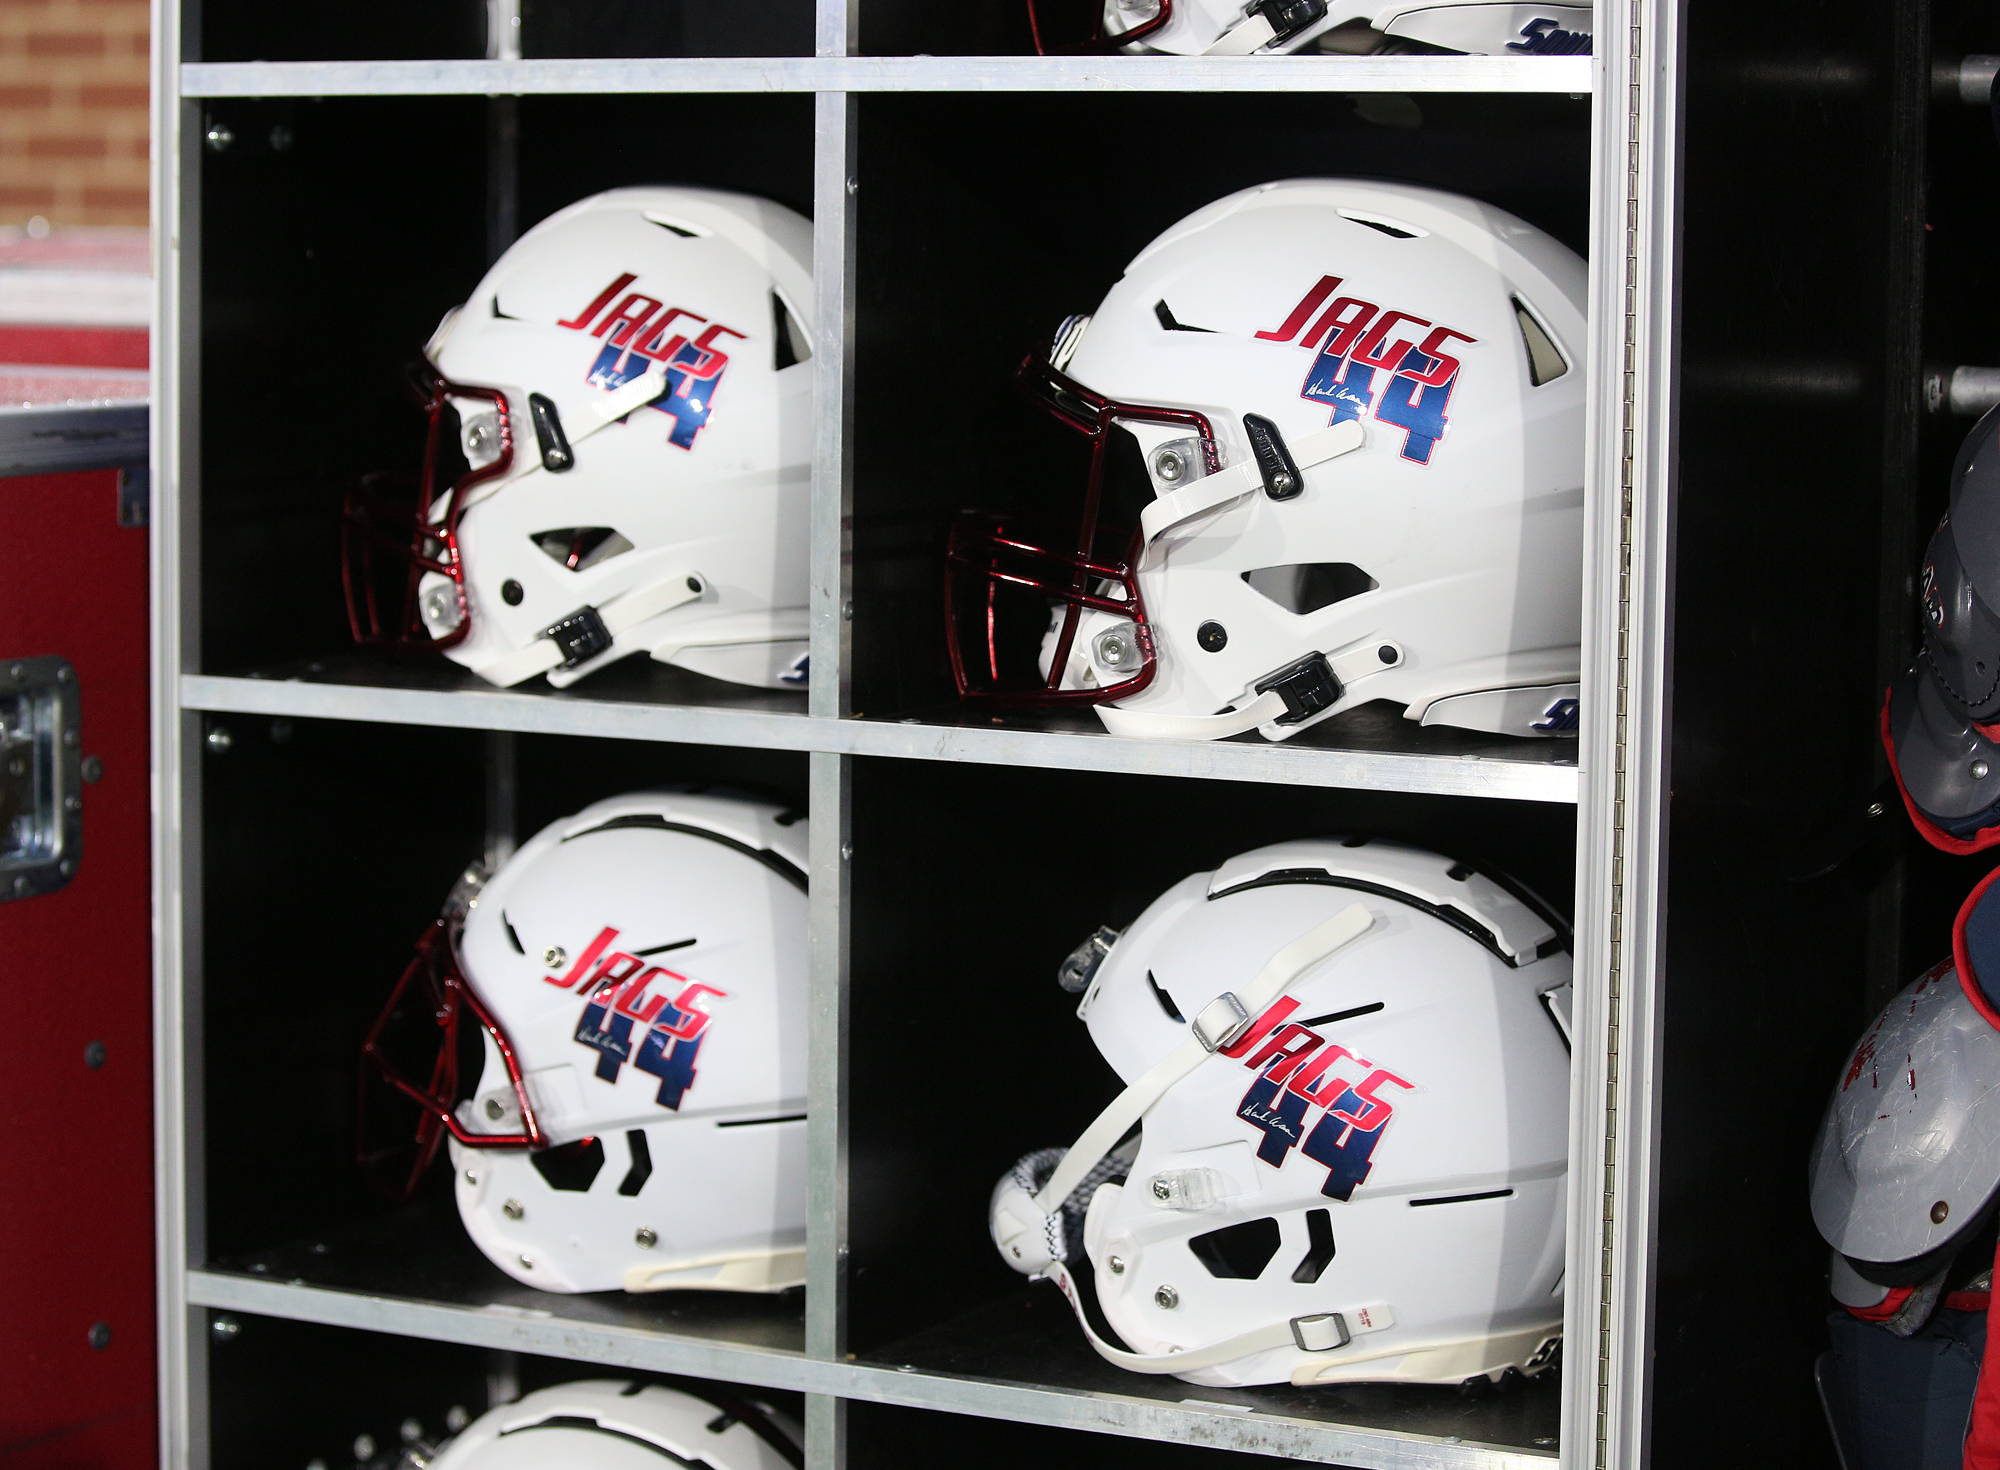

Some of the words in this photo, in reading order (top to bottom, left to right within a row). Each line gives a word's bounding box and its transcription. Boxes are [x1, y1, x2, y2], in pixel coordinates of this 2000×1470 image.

[556, 273, 748, 380] JAGS
[585, 321, 728, 451] 44
[1254, 275, 1478, 386] JAGS
[1300, 327, 1461, 465] 44
[543, 927, 728, 1040] JAGS
[573, 980, 709, 1111] 44
[1216, 995, 1415, 1131] JAGS
[1236, 1054, 1393, 1202] 44
